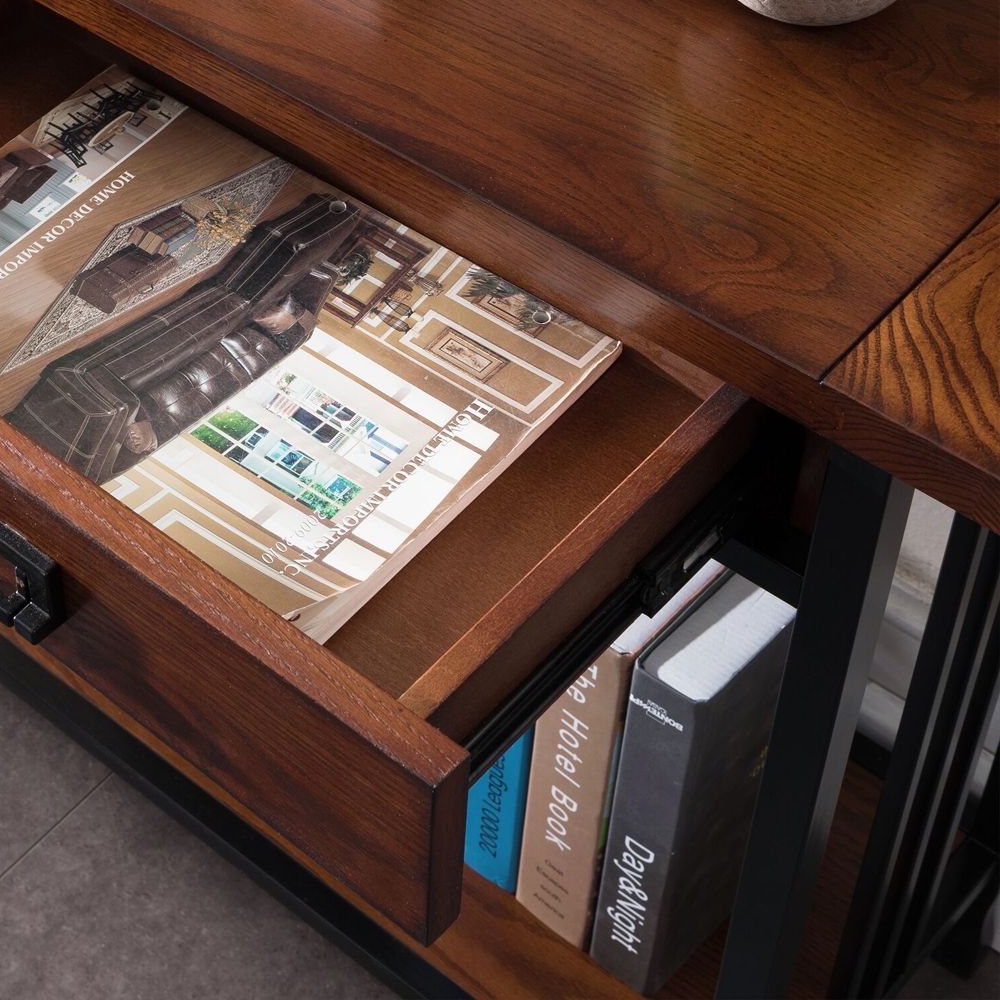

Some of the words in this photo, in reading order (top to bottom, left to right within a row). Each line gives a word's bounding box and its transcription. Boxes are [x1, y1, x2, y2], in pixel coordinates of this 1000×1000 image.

[89, 170, 136, 206] HOME
[40, 203, 94, 244] DECOR
[435, 398, 495, 447] HOME
[381, 443, 439, 491] DECOR
[566, 664, 598, 706] The
[554, 708, 589, 788] Hotel
[545, 787, 579, 851] Book
[606, 835, 655, 955] Day&Night
